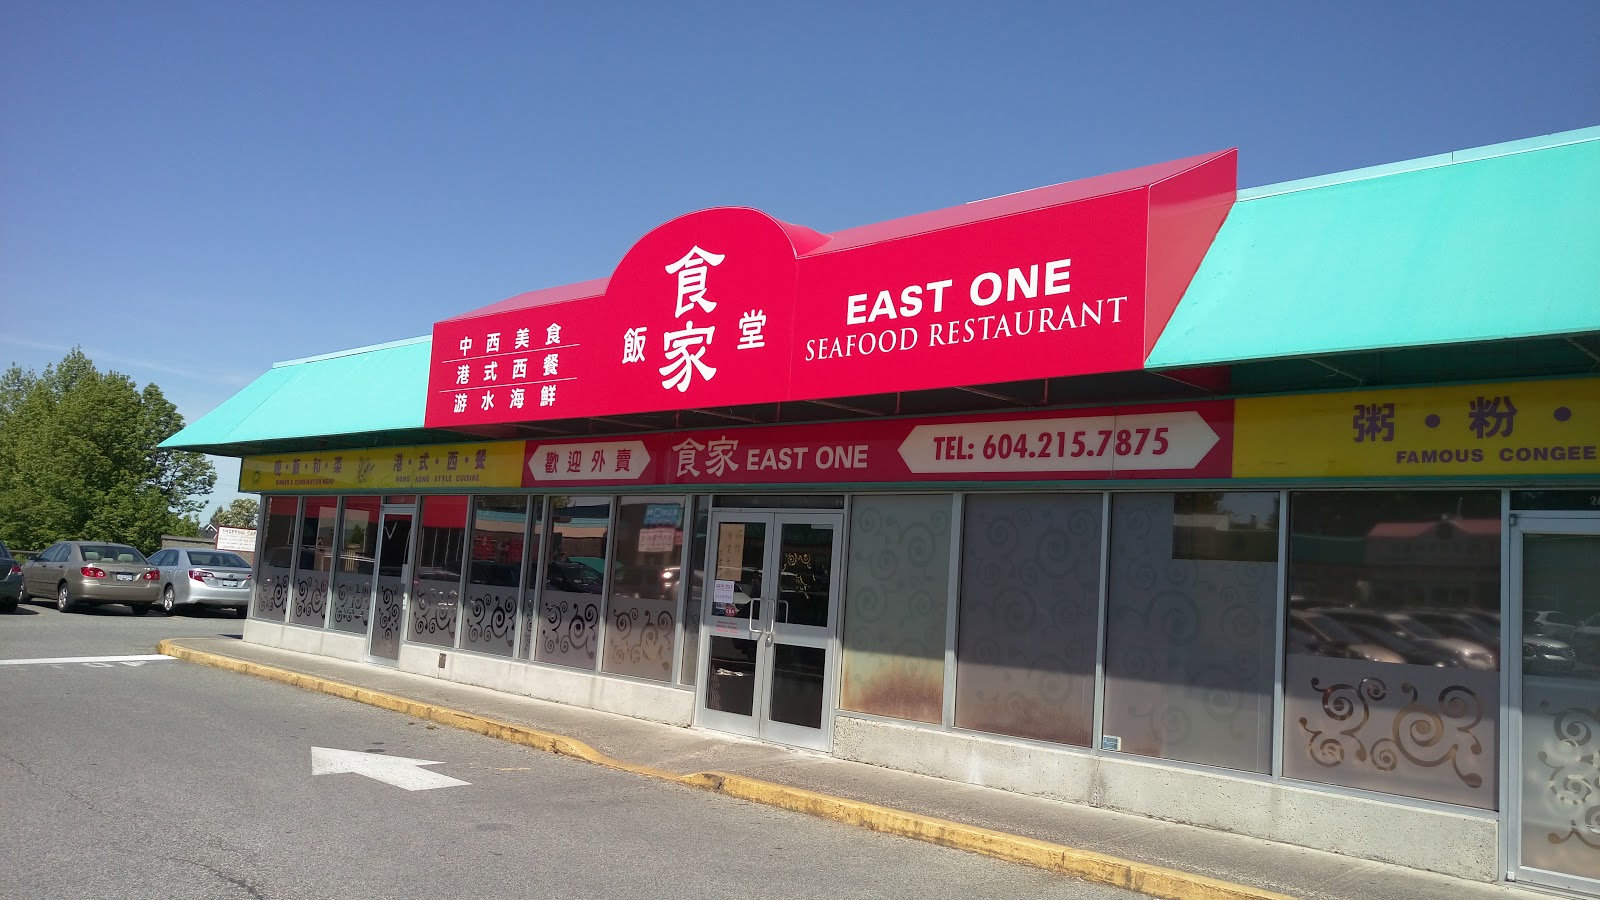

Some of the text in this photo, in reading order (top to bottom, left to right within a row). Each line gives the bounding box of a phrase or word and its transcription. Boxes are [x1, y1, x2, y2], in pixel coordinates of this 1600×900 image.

[846, 258, 1072, 325] EAST ONE
[659, 245, 726, 393] 食家
[805, 295, 1128, 362] SEAFOOD RESTAURANT
[544, 448, 632, 474] 歡迎外賣
[671, 435, 740, 478] 食家
[746, 444, 869, 471] EAST ONE
[933, 427, 1169, 461] TEL: 604.215.7875
[1396, 445, 1597, 464] FAMOUS CONGEE
[395, 474, 480, 483] HONG KONG STYLE CUISINE
